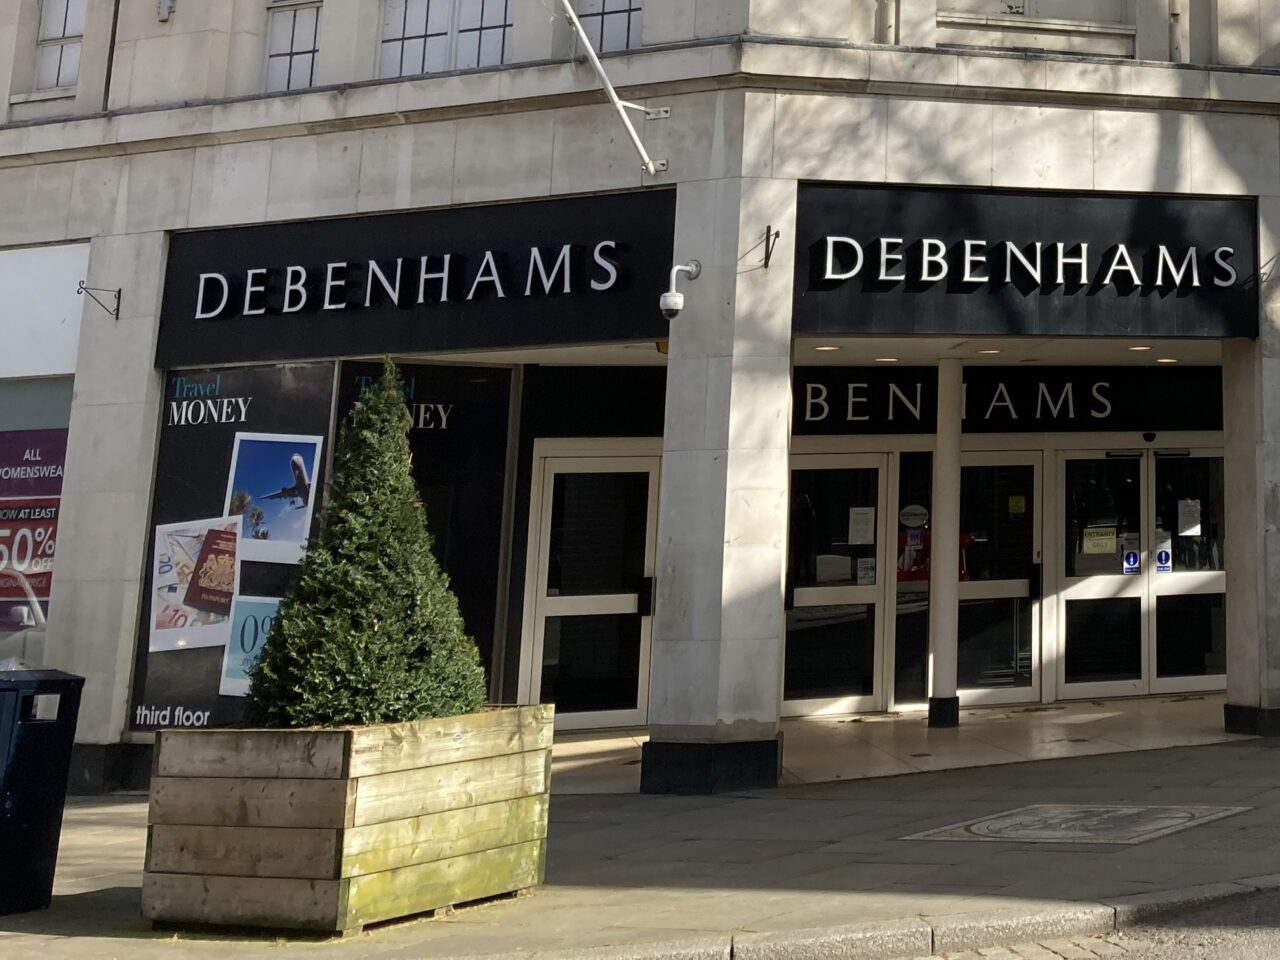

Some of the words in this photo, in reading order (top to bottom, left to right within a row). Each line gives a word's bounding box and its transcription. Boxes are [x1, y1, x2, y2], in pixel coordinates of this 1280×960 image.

[823, 235, 1238, 288] DEBENHAMS
[194, 240, 618, 320] DEBENHAMS
[171, 374, 221, 399] Travel
[167, 397, 253, 426] MONEY
[23, 448, 42, 461] ALL
[18, 509, 31, 520] AT
[31, 508, 56, 519] LEAST
[31, 556, 54, 572] OFF
[135, 705, 171, 725] third
[173, 705, 211, 726] floor
